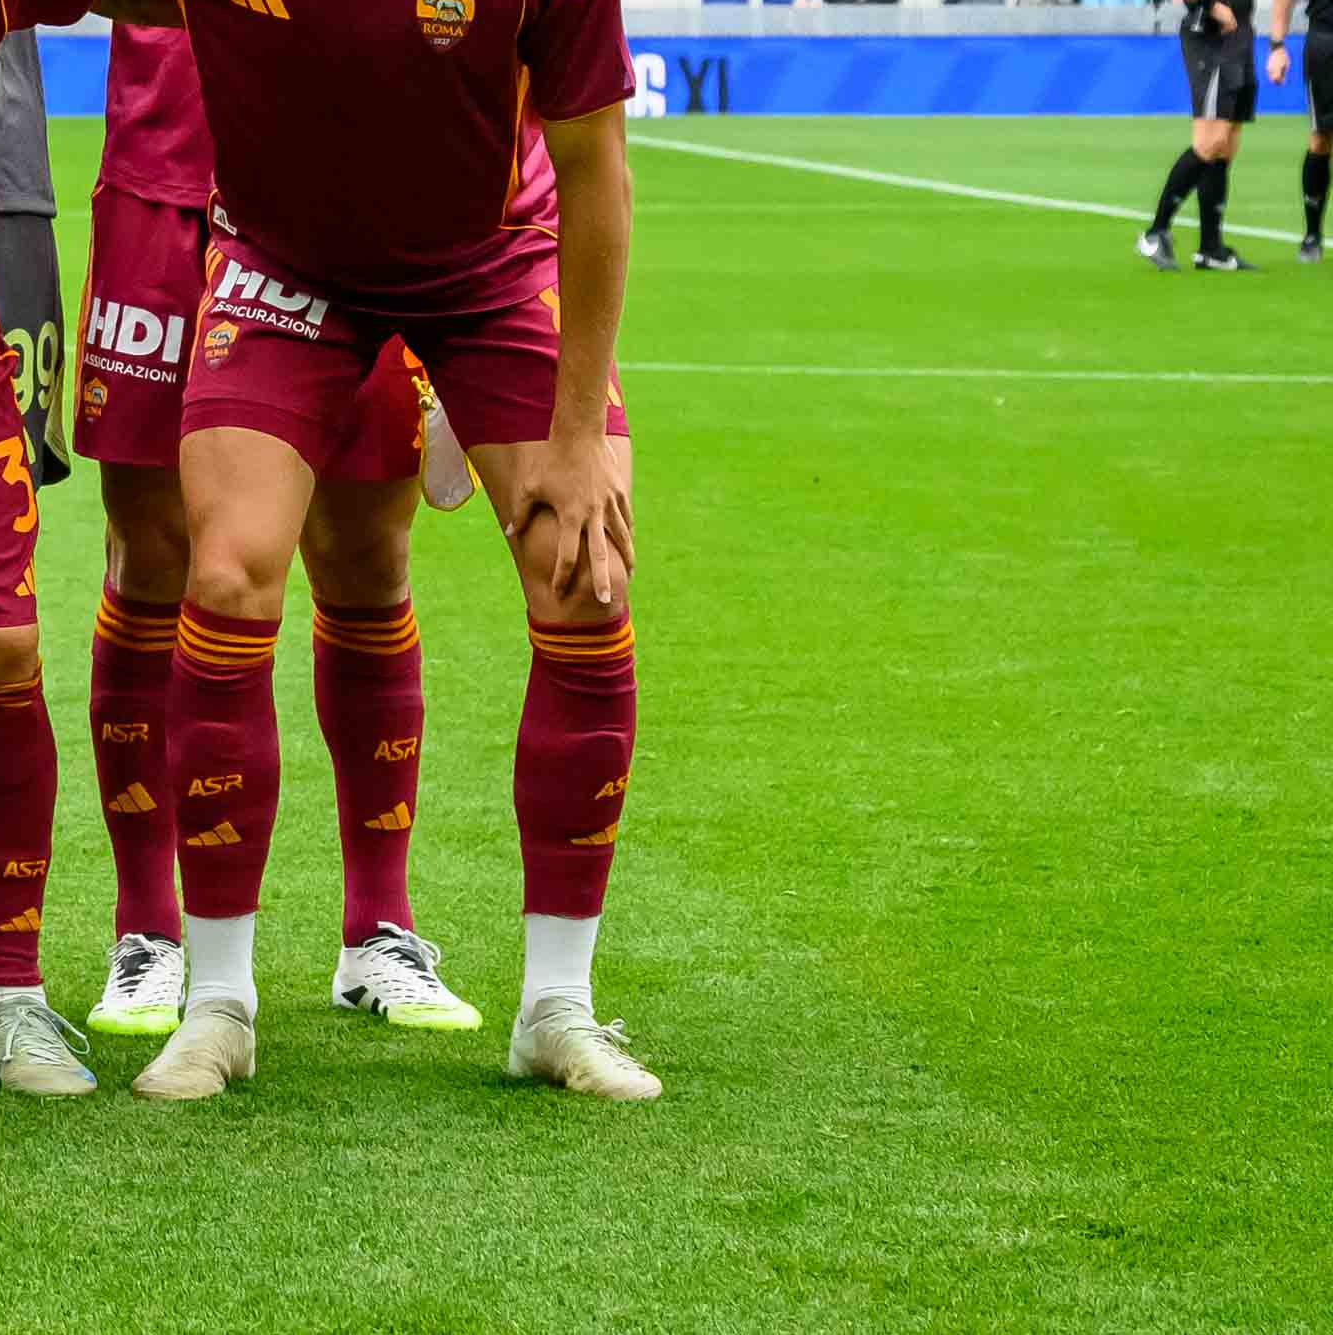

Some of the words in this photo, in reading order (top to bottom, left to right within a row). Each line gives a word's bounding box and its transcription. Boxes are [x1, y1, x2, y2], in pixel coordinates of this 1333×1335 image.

[422, 22, 464, 38] ROMA
[678, 57, 726, 116] XI
[86, 296, 186, 364] HDI
[374, 736, 418, 761] ASR
[188, 774, 244, 797] ASR
[2, 860, 47, 879] ASR
